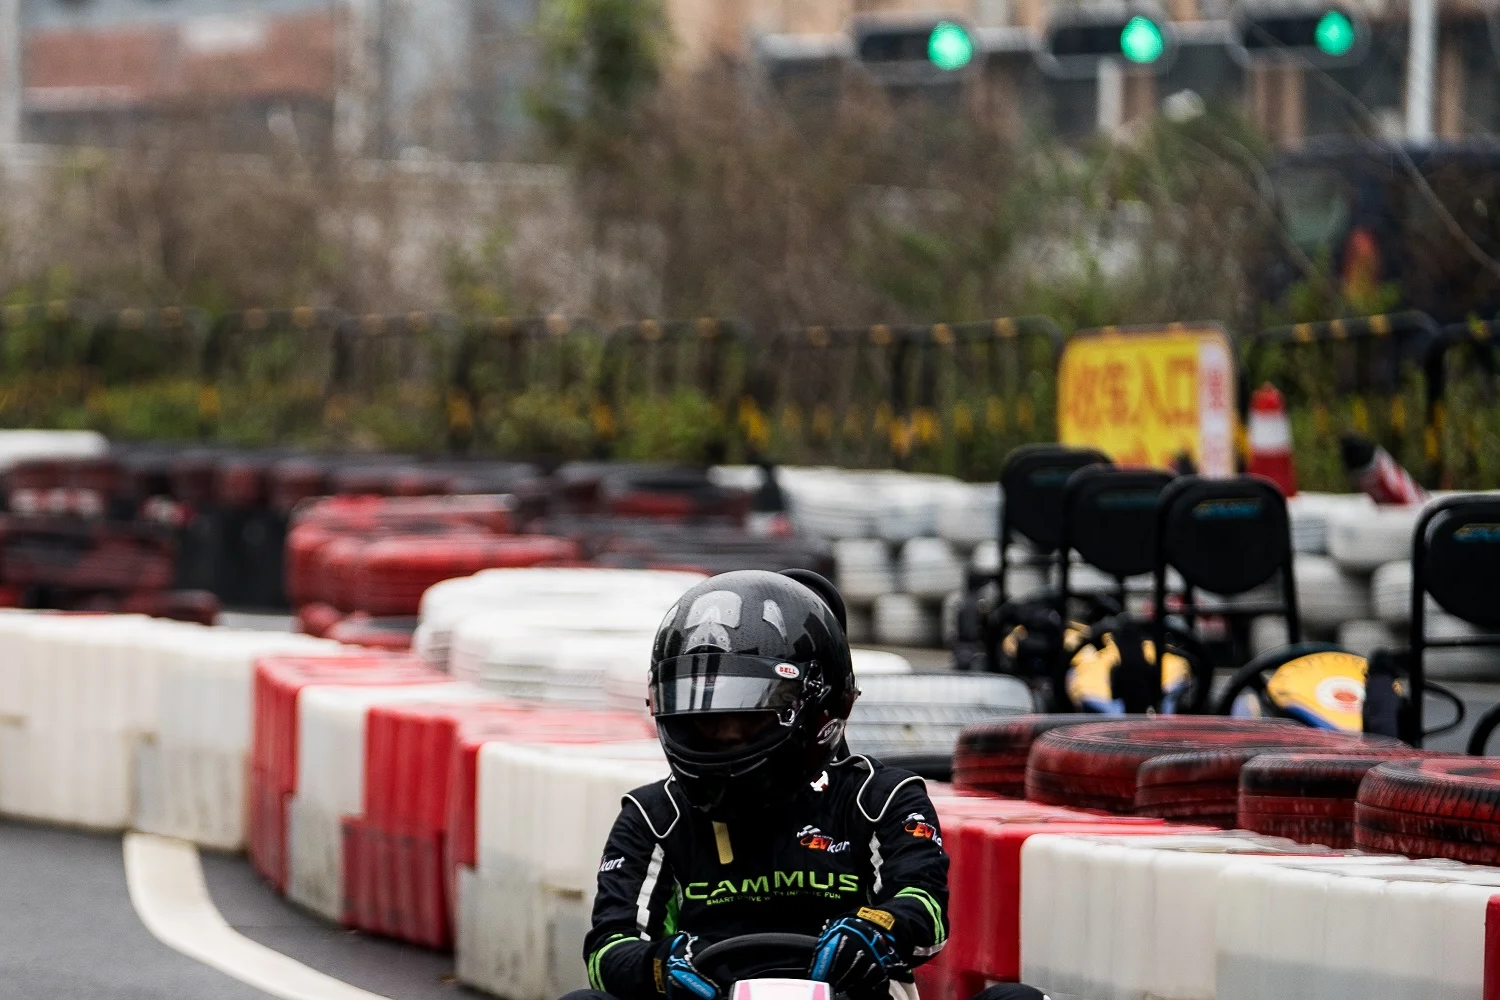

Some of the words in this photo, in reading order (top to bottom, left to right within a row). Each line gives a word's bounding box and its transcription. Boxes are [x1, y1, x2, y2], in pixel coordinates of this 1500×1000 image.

[779, 666, 797, 675] BELL
[808, 836, 851, 854] EVkar
[685, 870, 860, 901] CAMMUS
[706, 896, 734, 906] SMART
[824, 890, 842, 900] FUN
